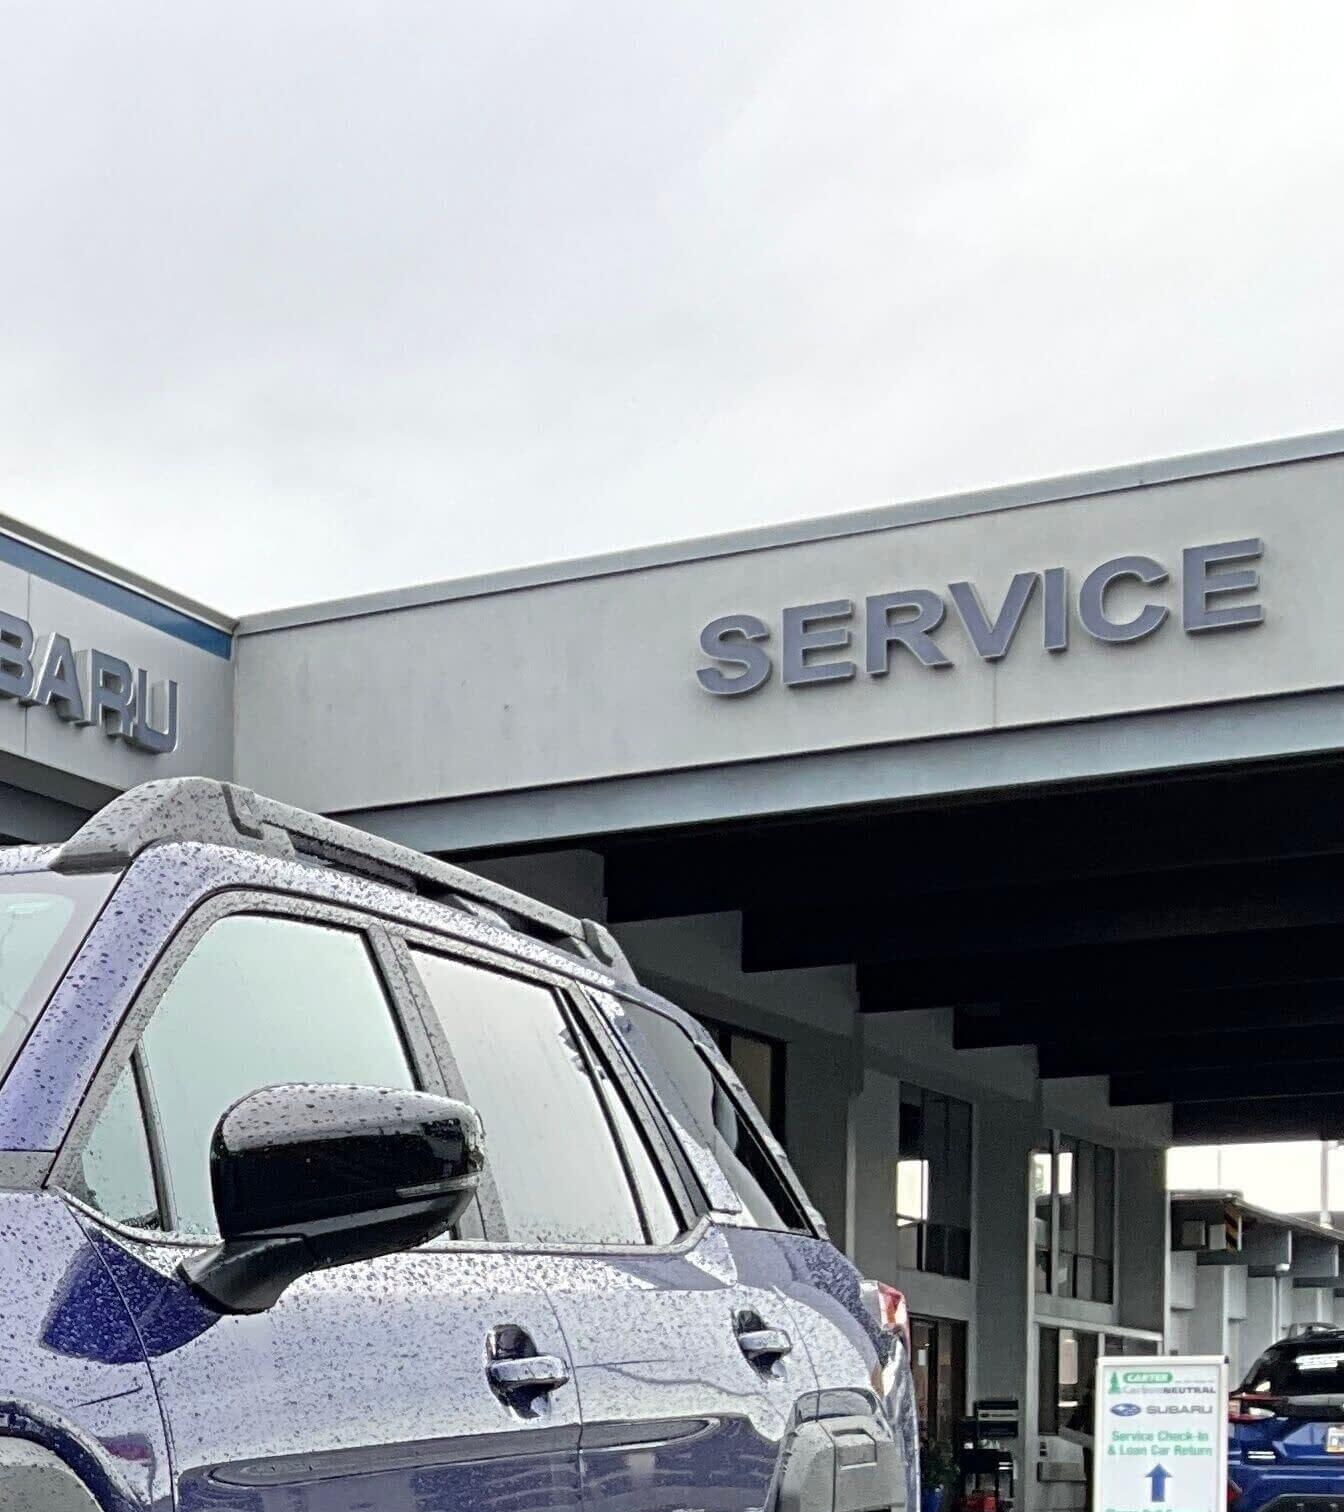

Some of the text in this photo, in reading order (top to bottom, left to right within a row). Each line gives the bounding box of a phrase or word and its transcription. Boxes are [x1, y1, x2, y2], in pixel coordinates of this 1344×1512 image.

[696, 537, 1265, 697] SERVICE
[1146, 1405, 1213, 1415] SUBARU
[1112, 1430, 1153, 1441] Service
[1107, 1445, 1213, 1456] & Loan Car Return
